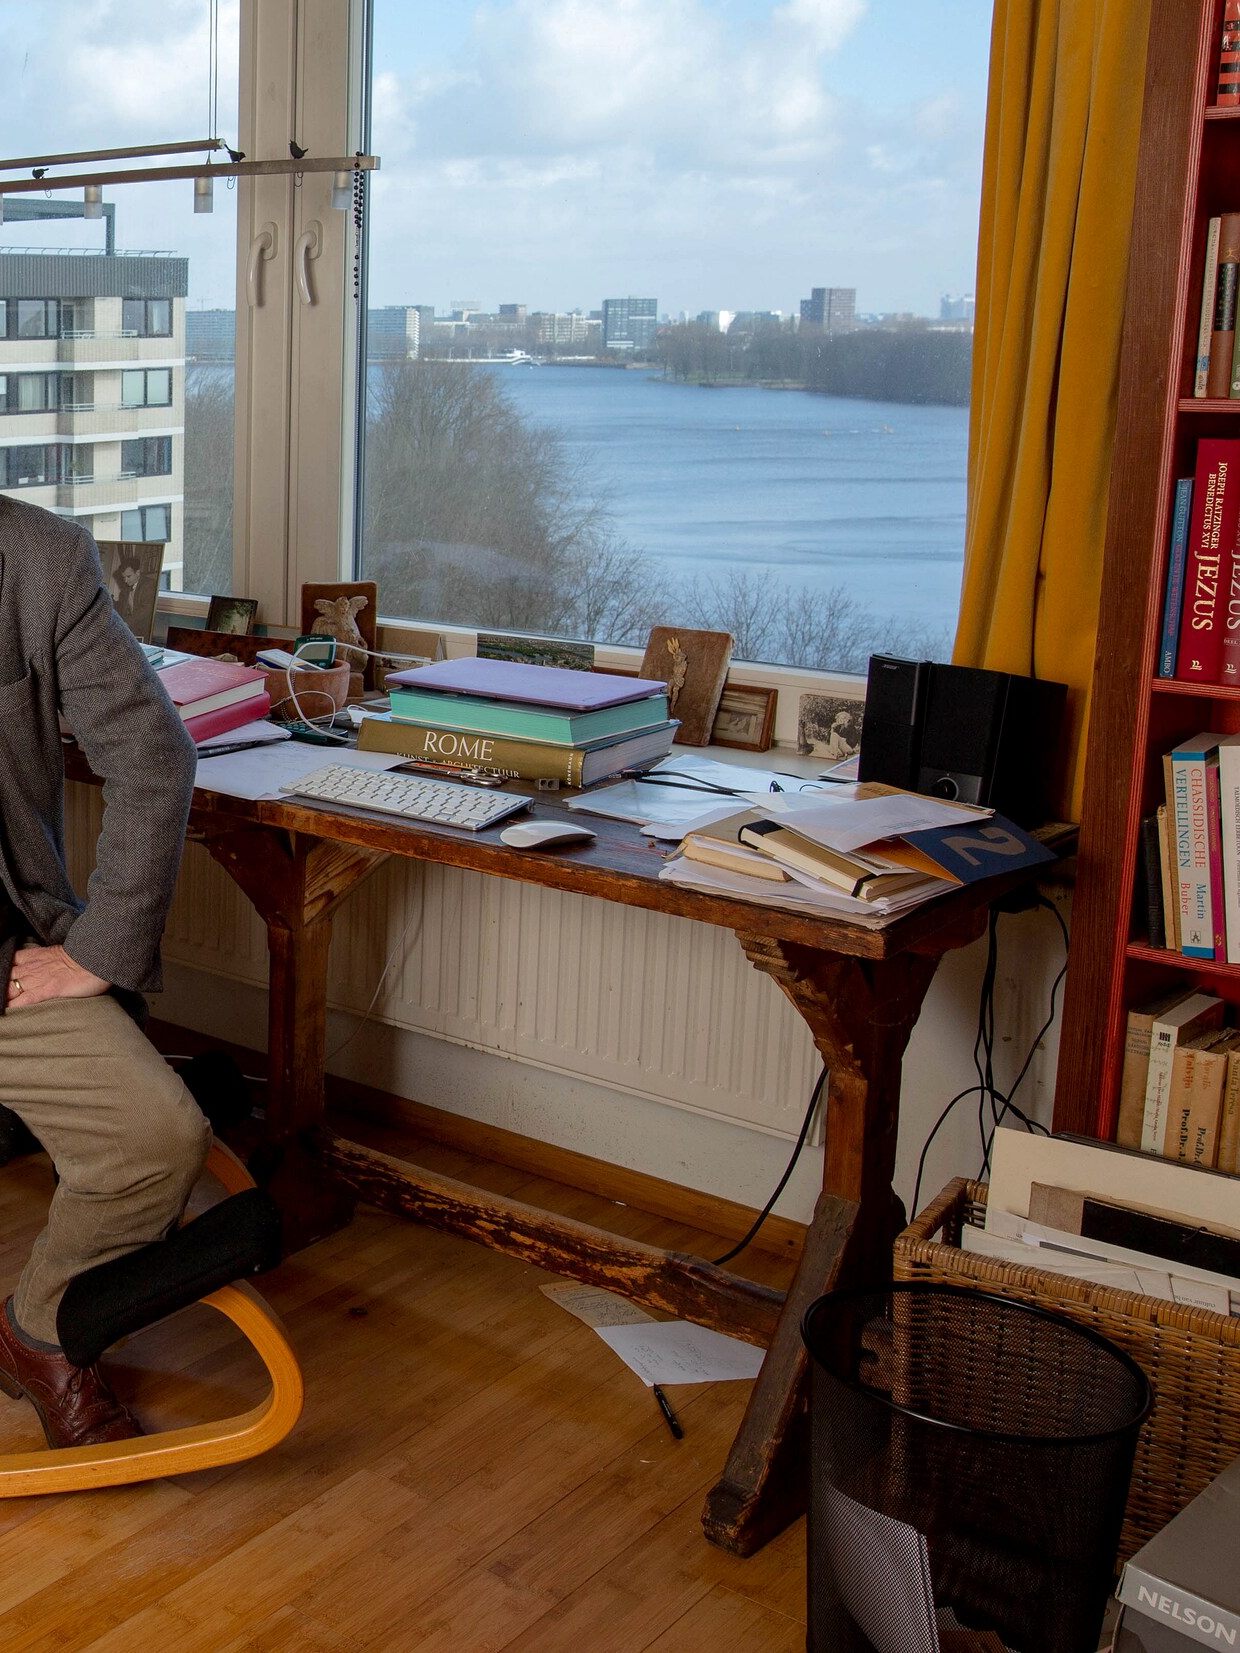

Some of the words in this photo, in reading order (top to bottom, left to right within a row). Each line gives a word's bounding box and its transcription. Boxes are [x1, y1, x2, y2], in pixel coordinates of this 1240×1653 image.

[1215, 461, 1228, 495] JOSEPH
[1202, 473, 1217, 530] BENEDICTUS
[1175, 506, 1186, 543] GUITTON
[1200, 531, 1212, 548] XVI
[1210, 497, 1224, 549] RATZINGER
[1191, 550, 1222, 631] JEZUS
[1163, 650, 1172, 674] AMBO
[423, 731, 495, 762] ROME
[1175, 769, 1191, 869] VERTELLINGEN
[1190, 768, 1206, 869] CHASSIDISCHE
[941, 826, 1029, 867] 2
[1180, 882, 1191, 916] Buber
[1196, 883, 1207, 920] Martin
[1228, 1087, 1239, 1115] Teresa
[1179, 1108, 1191, 1150] Prof.Dr.
[1137, 1585, 1237, 1646] NELSON
